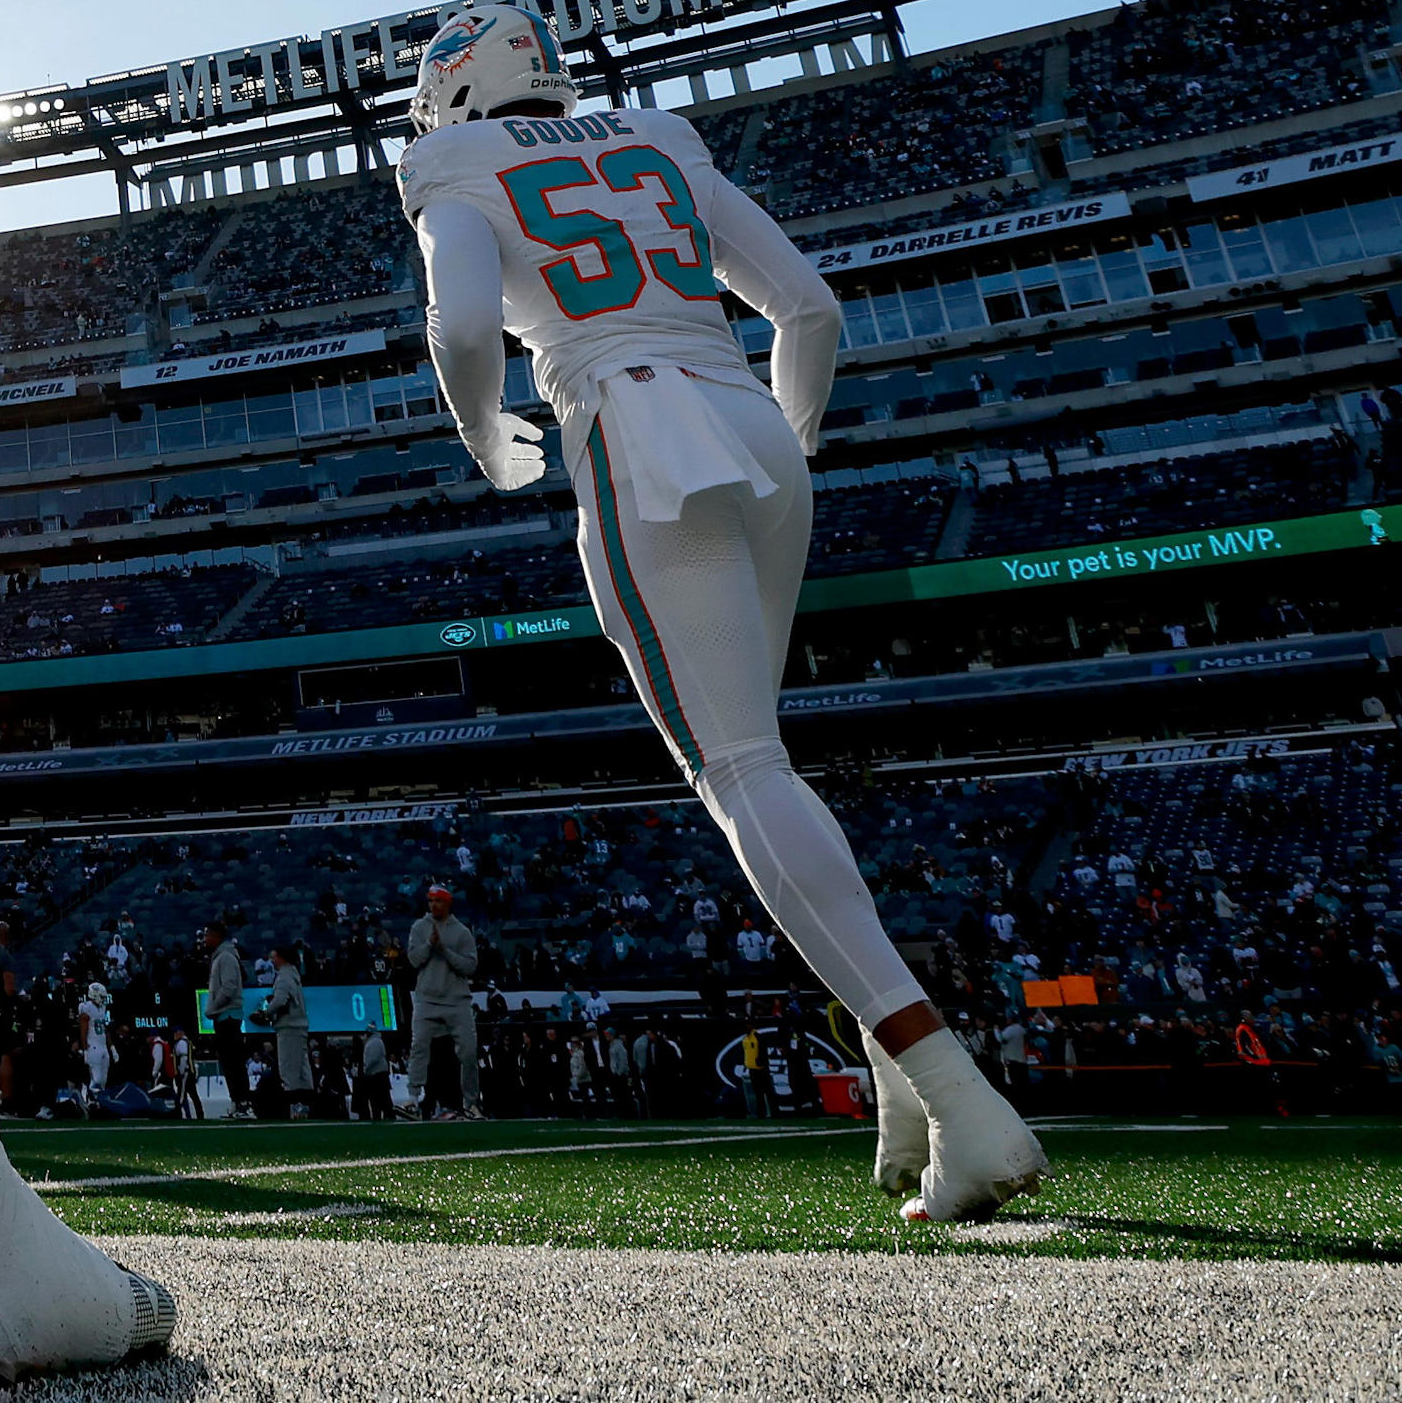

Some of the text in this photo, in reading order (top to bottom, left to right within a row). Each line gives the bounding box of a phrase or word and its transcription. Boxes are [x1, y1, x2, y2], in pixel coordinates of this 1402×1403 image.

[165, 16, 417, 124] METLIFE
[1308, 140, 1397, 173] MATT
[495, 144, 720, 321] 53
[818, 200, 1104, 269] 24 DARRELLE REVIS
[154, 340, 348, 379] 12 JOE NAMATH
[1002, 527, 1283, 582] Your pet is your MVP.
[516, 618, 571, 636] MetLife
[1198, 648, 1313, 670] MetLife
[783, 690, 882, 710] MetLife
[271, 723, 498, 755] METLIFE STADIUM
[1133, 743, 1214, 765] YORK
[1216, 738, 1290, 758] JETS
[289, 812, 344, 826] NEW
[346, 808, 402, 823] YORK
[135, 1016, 169, 1029] BALL ON
